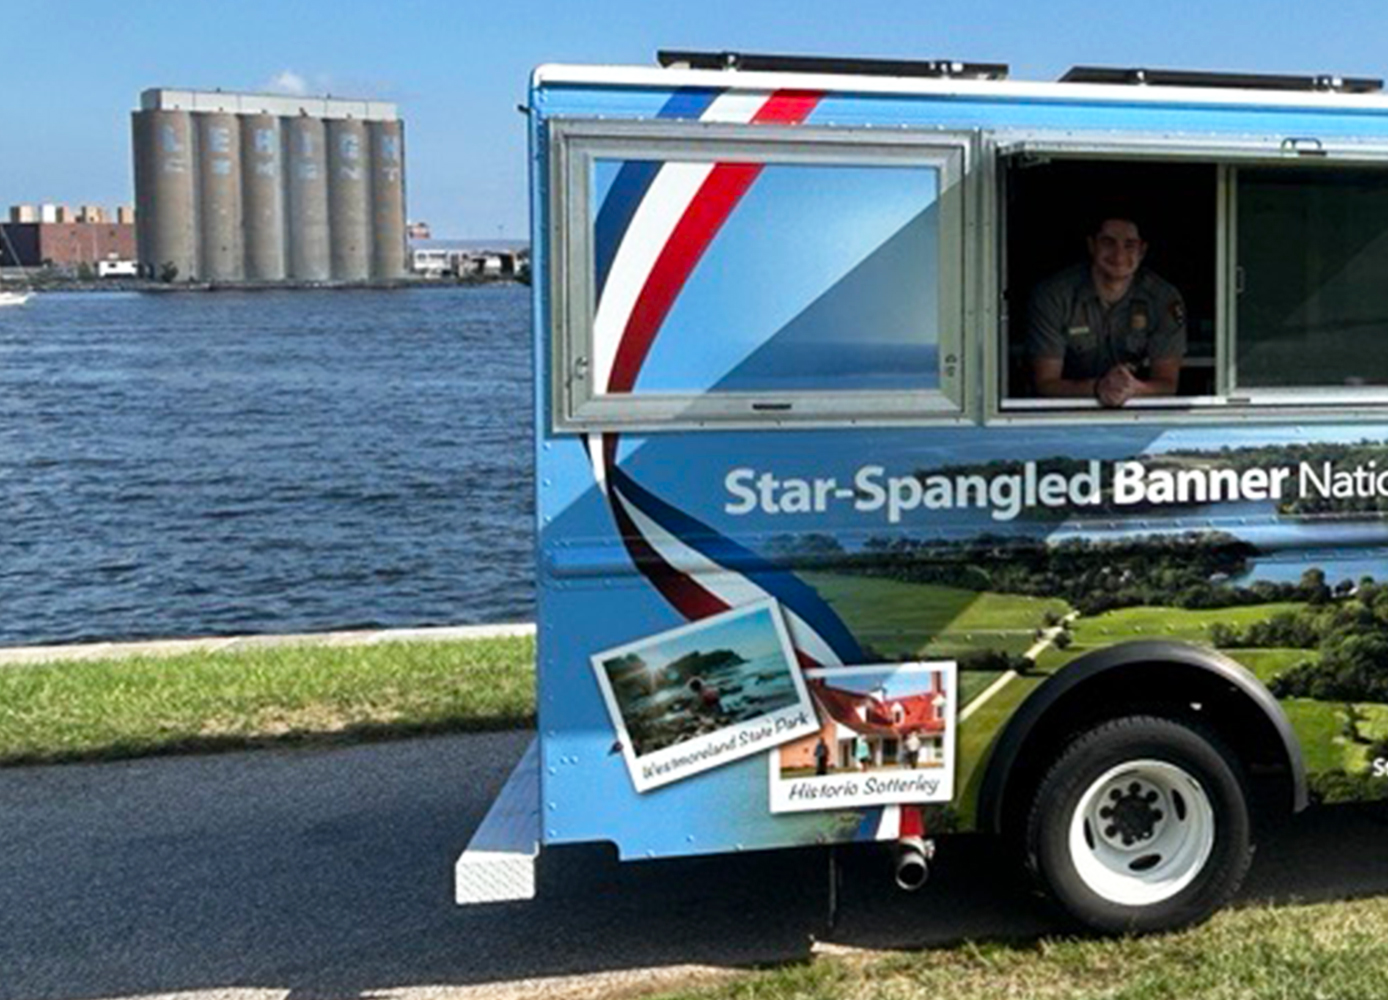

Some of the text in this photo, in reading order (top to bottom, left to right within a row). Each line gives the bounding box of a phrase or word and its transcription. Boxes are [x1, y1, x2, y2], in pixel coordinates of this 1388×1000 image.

[724, 461, 1100, 523] Star-Spangled
[1113, 462, 1289, 504] Banner
[642, 711, 810, 780] Westmoreland State Park
[864, 777, 940, 797] Sotterley
